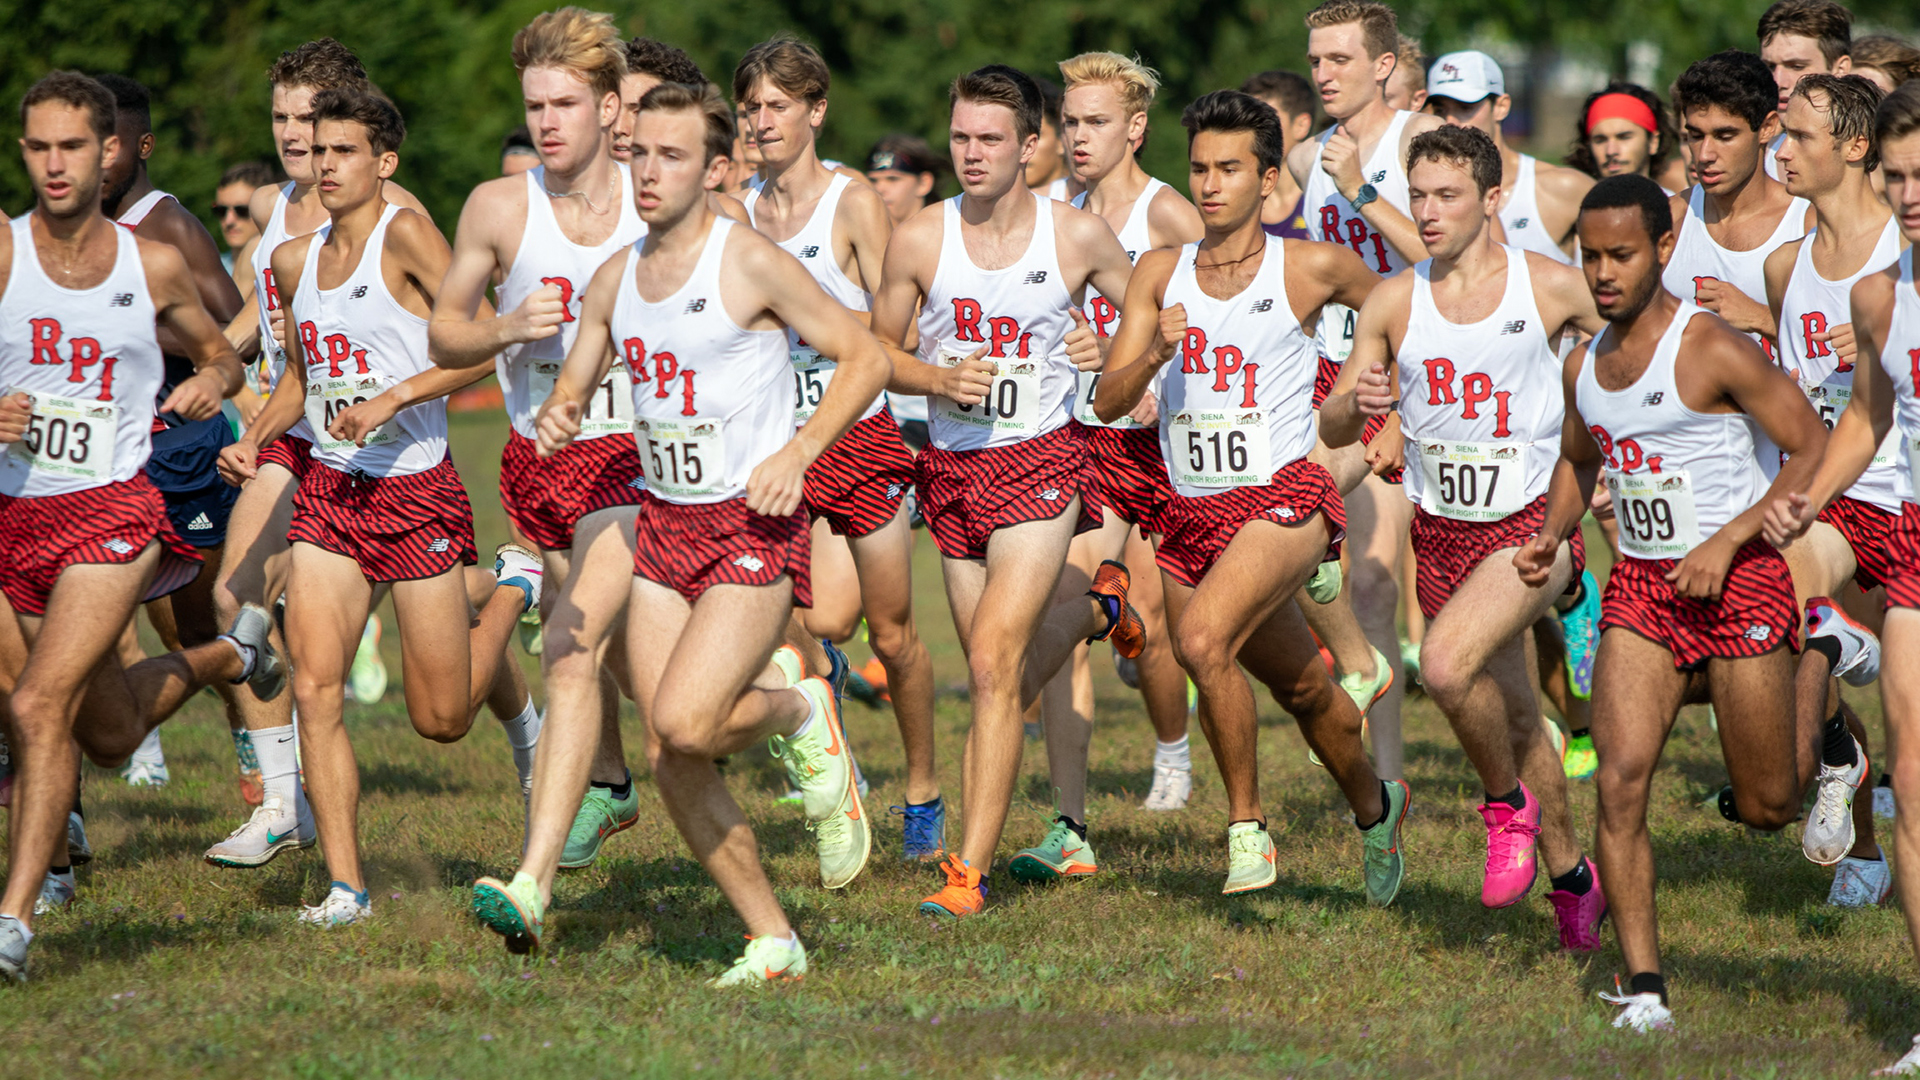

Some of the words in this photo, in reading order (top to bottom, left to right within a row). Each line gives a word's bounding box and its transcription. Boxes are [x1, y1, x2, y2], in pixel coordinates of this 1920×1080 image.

[1319, 204, 1393, 274] RPI
[29, 317, 121, 401] RPI
[1180, 326, 1258, 409] RPI
[327, 381, 347, 389] SIENA
[622, 337, 698, 416] RPI
[1422, 357, 1512, 438] RPI
[795, 411, 808, 419] GHT
[947, 411, 971, 423] FINISH
[971, 416, 995, 427] RIGHT
[997, 421, 1025, 430] TIMING
[1200, 413, 1225, 421] SIENA
[599, 422, 629, 431] TIMING
[1207, 421, 1232, 430] INVITE
[25, 414, 91, 465] 503
[1455, 444, 1479, 454] SIENA
[1188, 430, 1248, 473] 516
[1448, 453, 1459, 461] XC
[1460, 455, 1487, 463] INVITE
[647, 438, 703, 485] 515
[1184, 474, 1204, 483] FINISH
[1205, 476, 1228, 484] RIGHT
[1229, 474, 1258, 484] TIMING
[1438, 462, 1500, 507] 507
[1435, 504, 1455, 515] FINISH
[1456, 509, 1479, 518] RIGHT
[1481, 511, 1510, 519] TIMING
[1621, 497, 1675, 542] 499
[1659, 543, 1688, 553] TIMING
